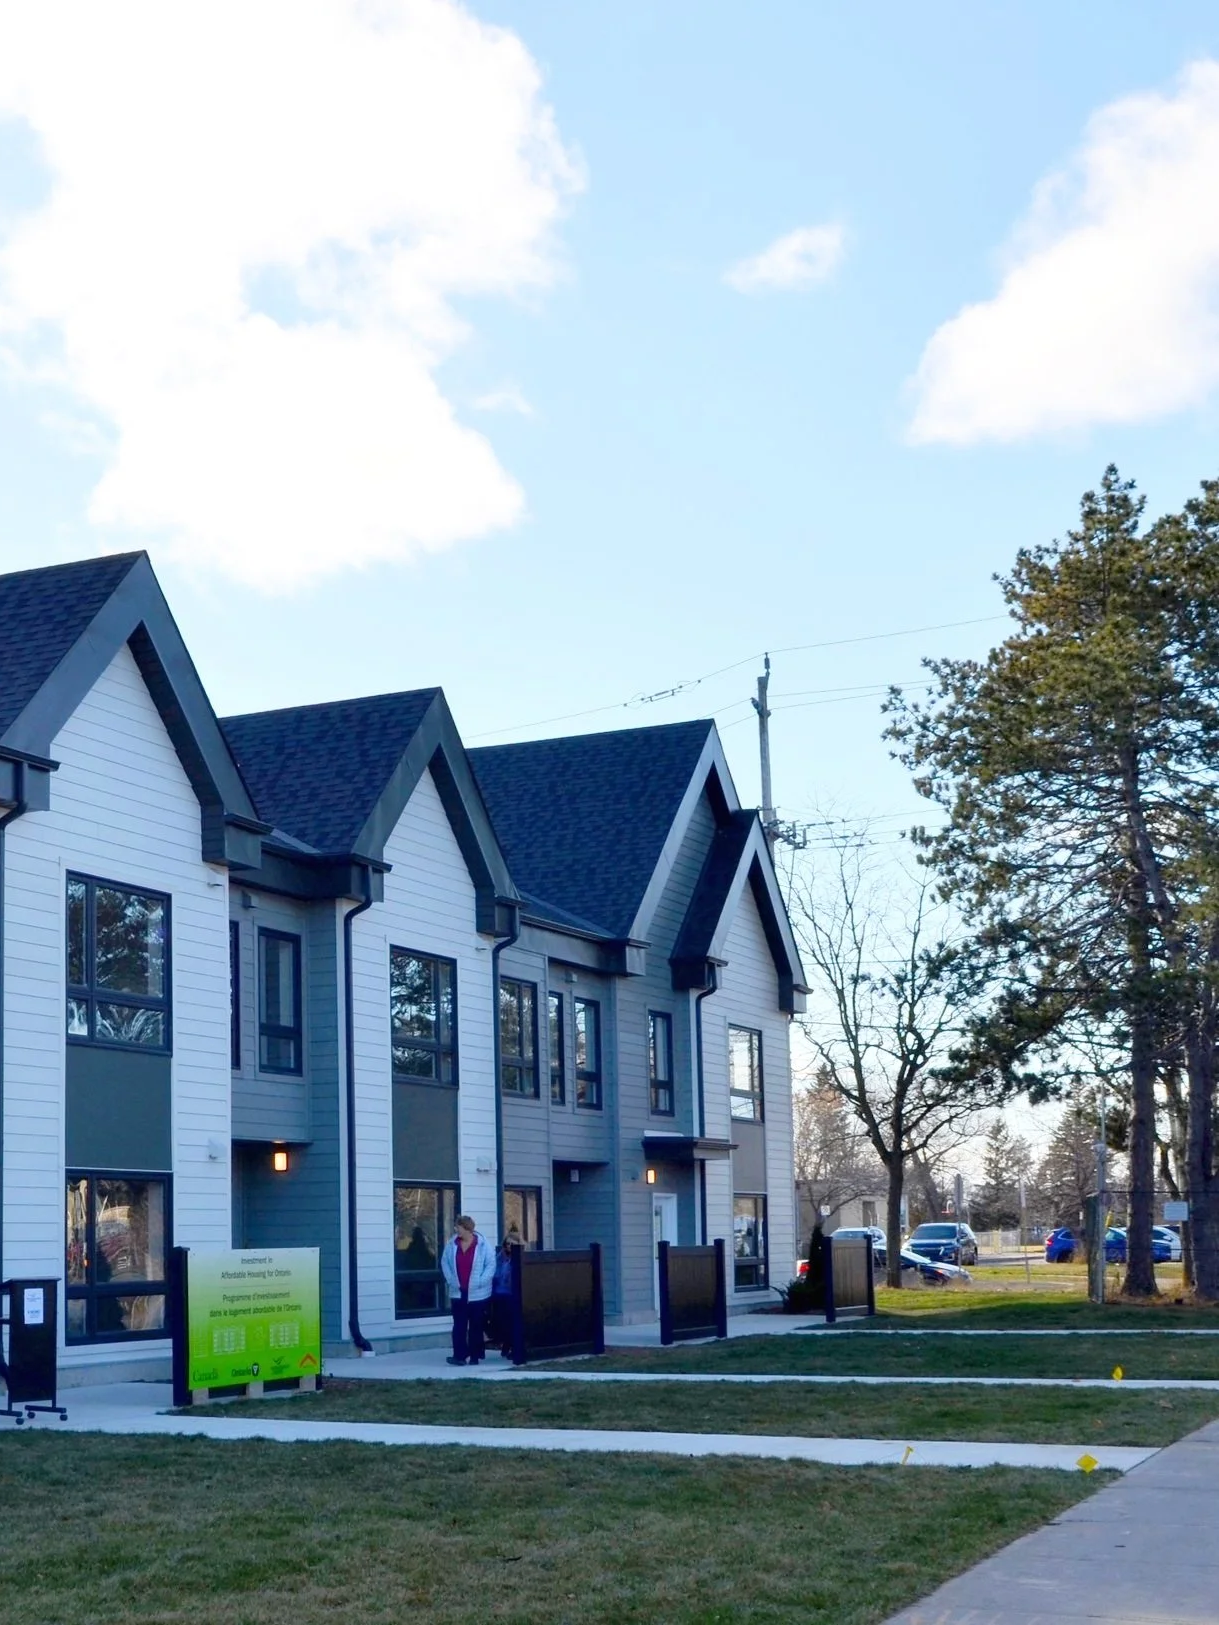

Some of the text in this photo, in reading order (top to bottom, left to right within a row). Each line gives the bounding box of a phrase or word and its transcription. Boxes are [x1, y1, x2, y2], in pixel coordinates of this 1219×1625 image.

[241, 1256, 267, 1265] Investment
[221, 1270, 246, 1279] Affordable
[247, 1270, 266, 1279] Housing
